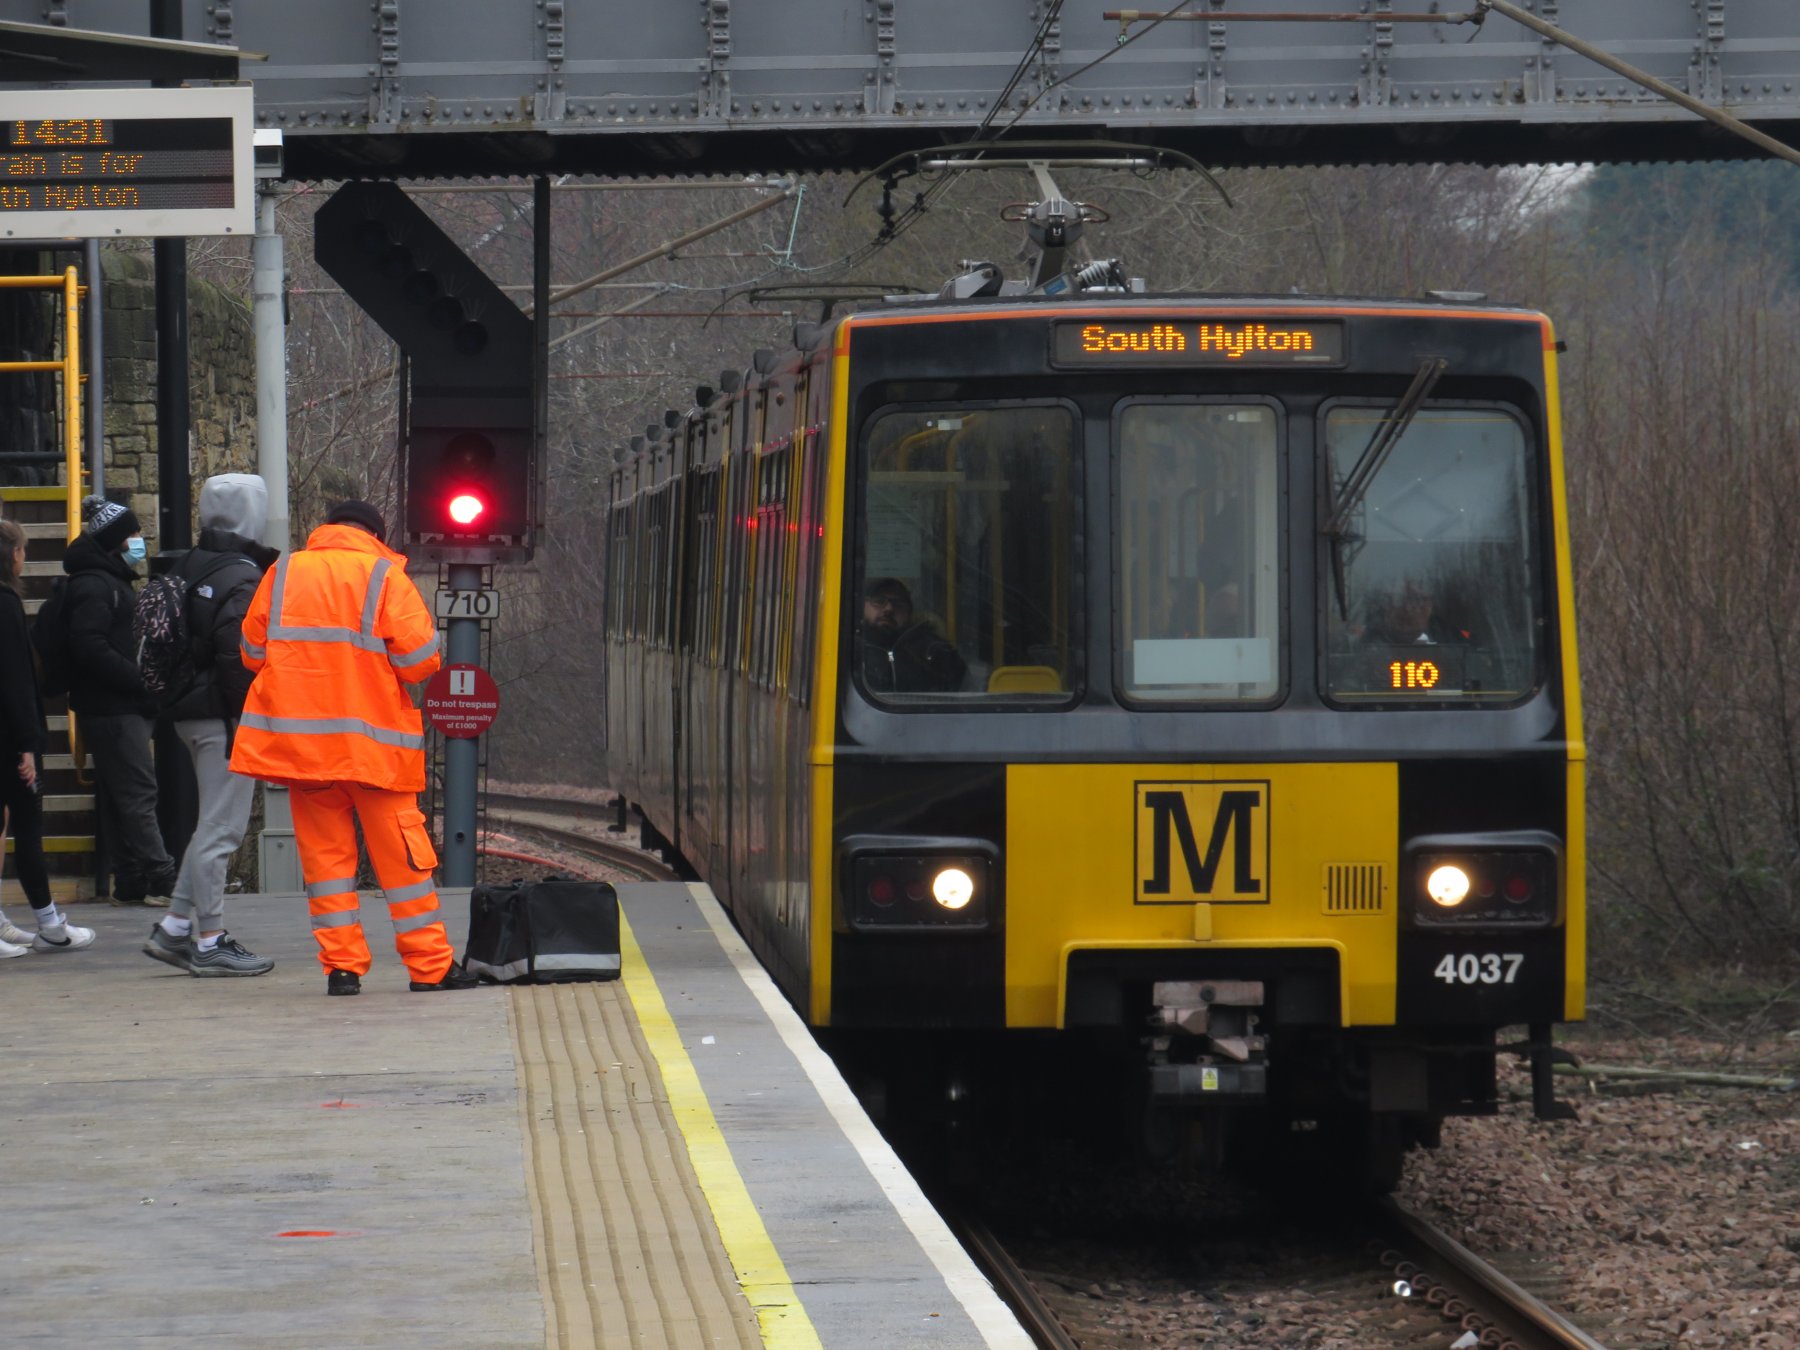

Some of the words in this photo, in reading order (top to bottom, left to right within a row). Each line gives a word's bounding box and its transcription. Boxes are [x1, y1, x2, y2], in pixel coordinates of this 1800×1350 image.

[12, 119, 109, 145] 14:31
[60, 153, 84, 174] is
[99, 152, 144, 173] for
[44, 185, 139, 210] Hylton
[1082, 325, 1185, 352] South
[1200, 324, 1313, 357] Hylton
[444, 593, 491, 615] 710
[1389, 661, 1440, 688] 110
[442, 700, 456, 708] not
[458, 700, 497, 709] trespass
[1143, 791, 1261, 893] M
[1434, 954, 1525, 984] 4037
